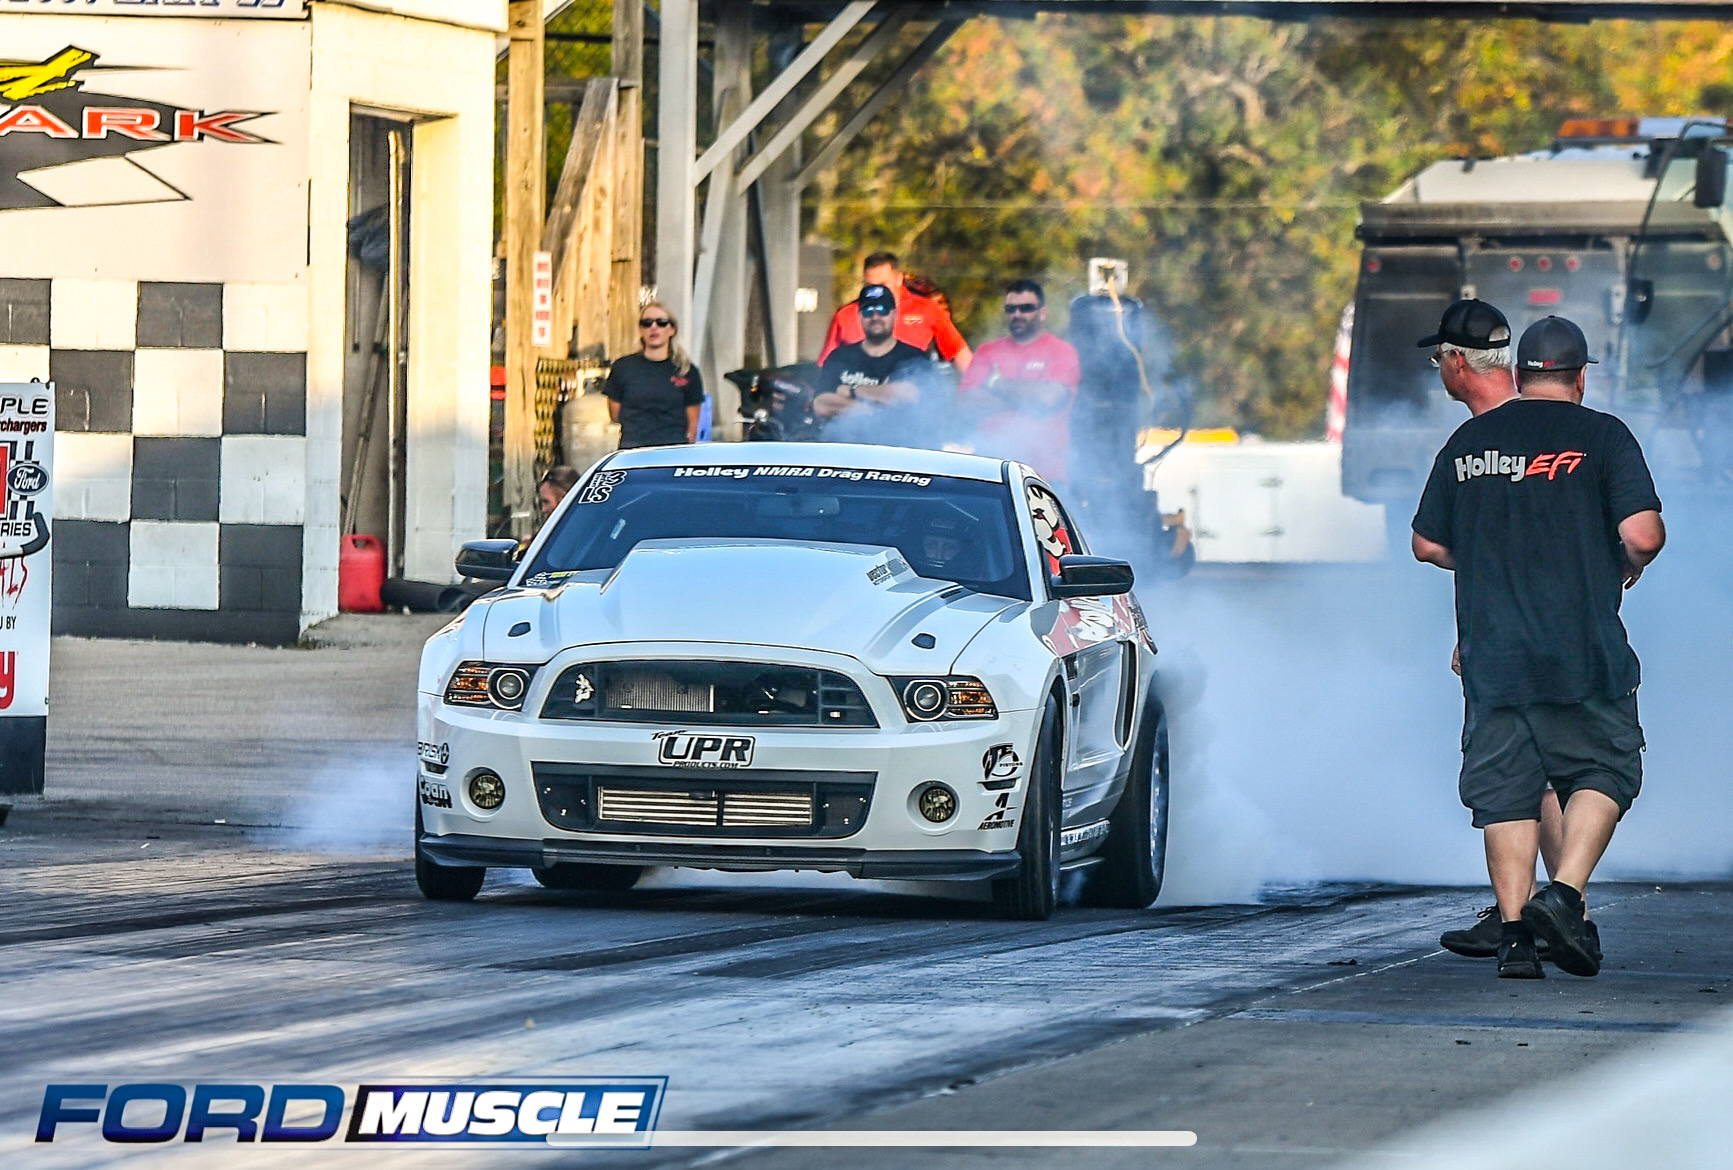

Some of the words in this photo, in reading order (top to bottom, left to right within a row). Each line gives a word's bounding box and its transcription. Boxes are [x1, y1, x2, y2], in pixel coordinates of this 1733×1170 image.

[0, 104, 280, 145] ARK
[0, 396, 49, 415] PLE
[673, 466, 749, 479] Holley
[753, 466, 814, 478] NMRA
[816, 467, 864, 482] Drag
[864, 471, 932, 487] Racing
[1455, 450, 1526, 482] Holley
[13, 466, 41, 490] Ford
[0, 522, 32, 537] RIES
[6, 616, 17, 630] BY
[662, 736, 752, 762] UPR
[977, 819, 1015, 831] AEROMOTIVE
